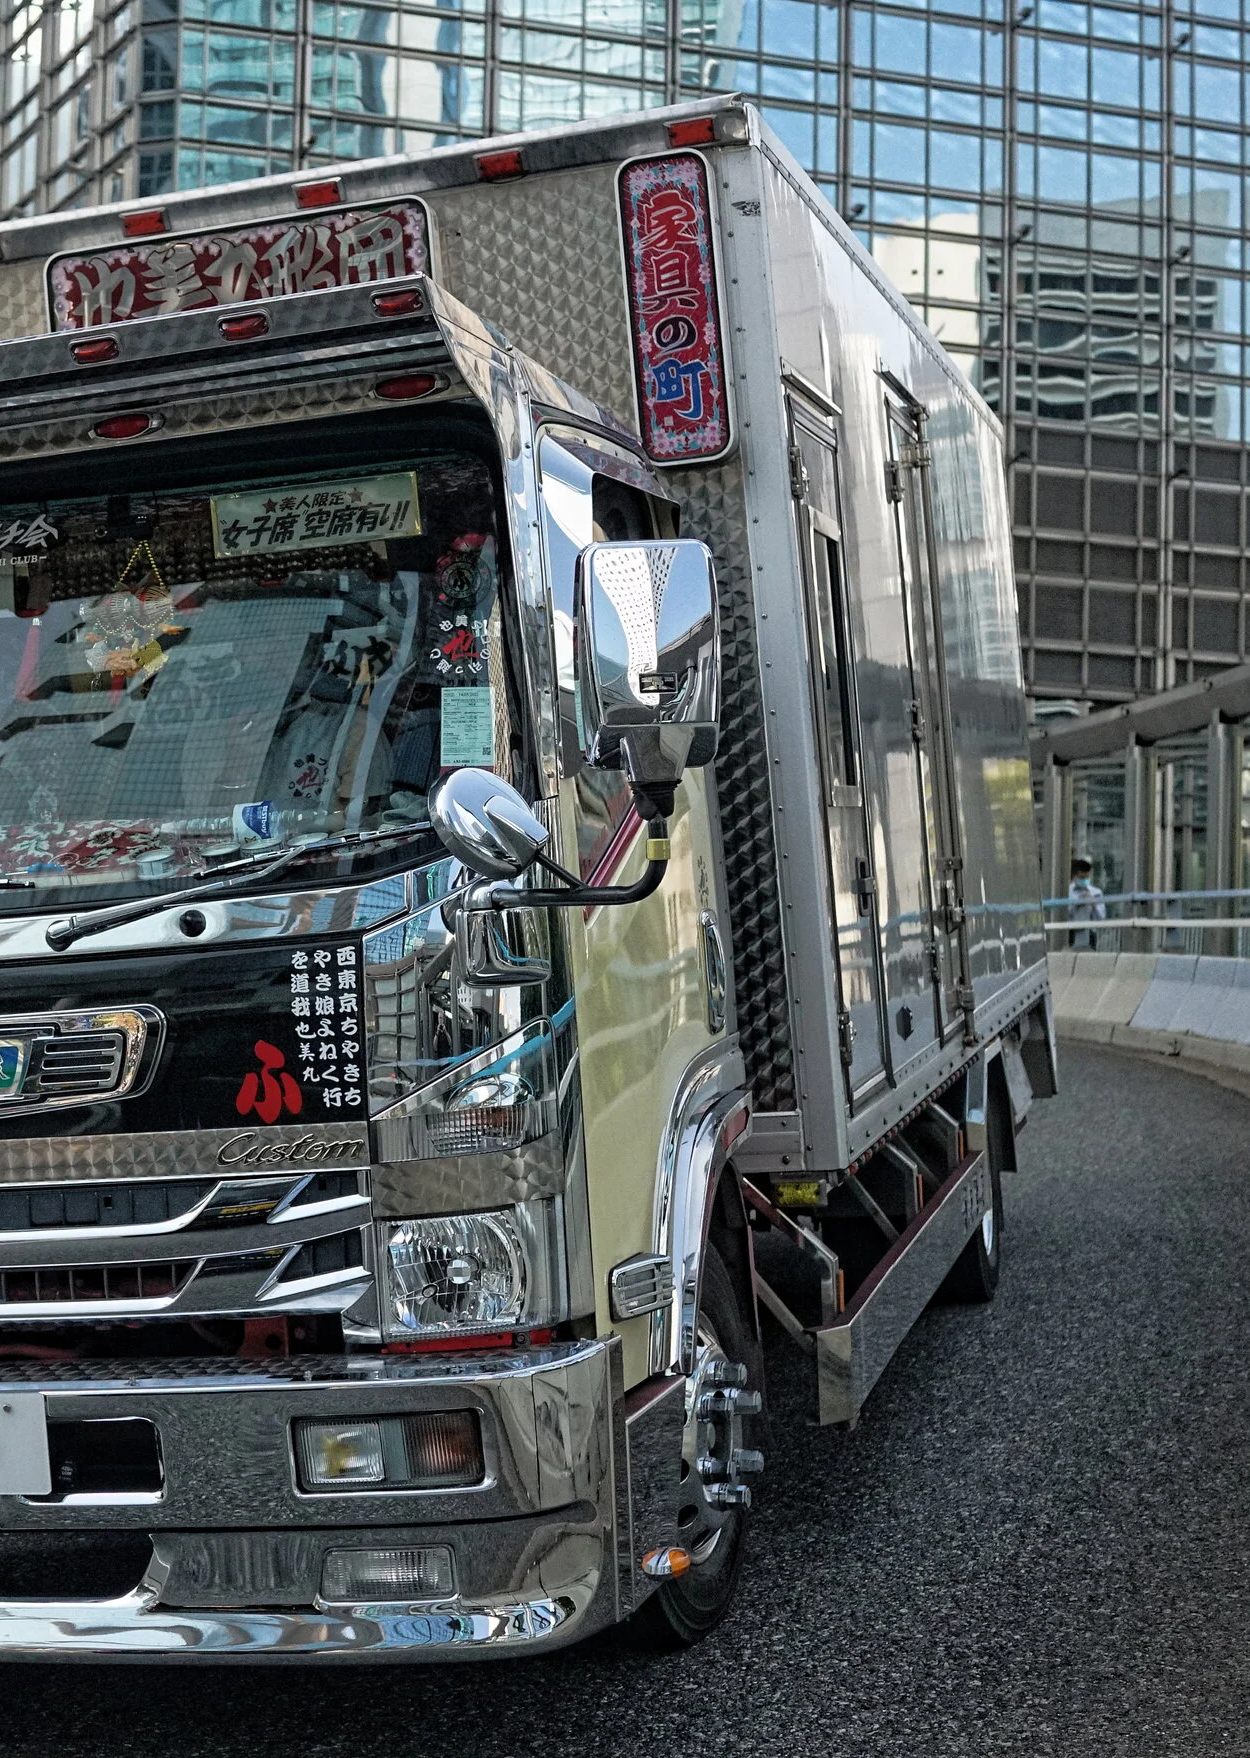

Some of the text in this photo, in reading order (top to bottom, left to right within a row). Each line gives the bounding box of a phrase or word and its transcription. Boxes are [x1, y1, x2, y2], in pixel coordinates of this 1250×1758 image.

[279, 490, 347, 512] 美人限定
[236, 1039, 302, 1124] ふ
[216, 1132, 365, 1167] Custom
